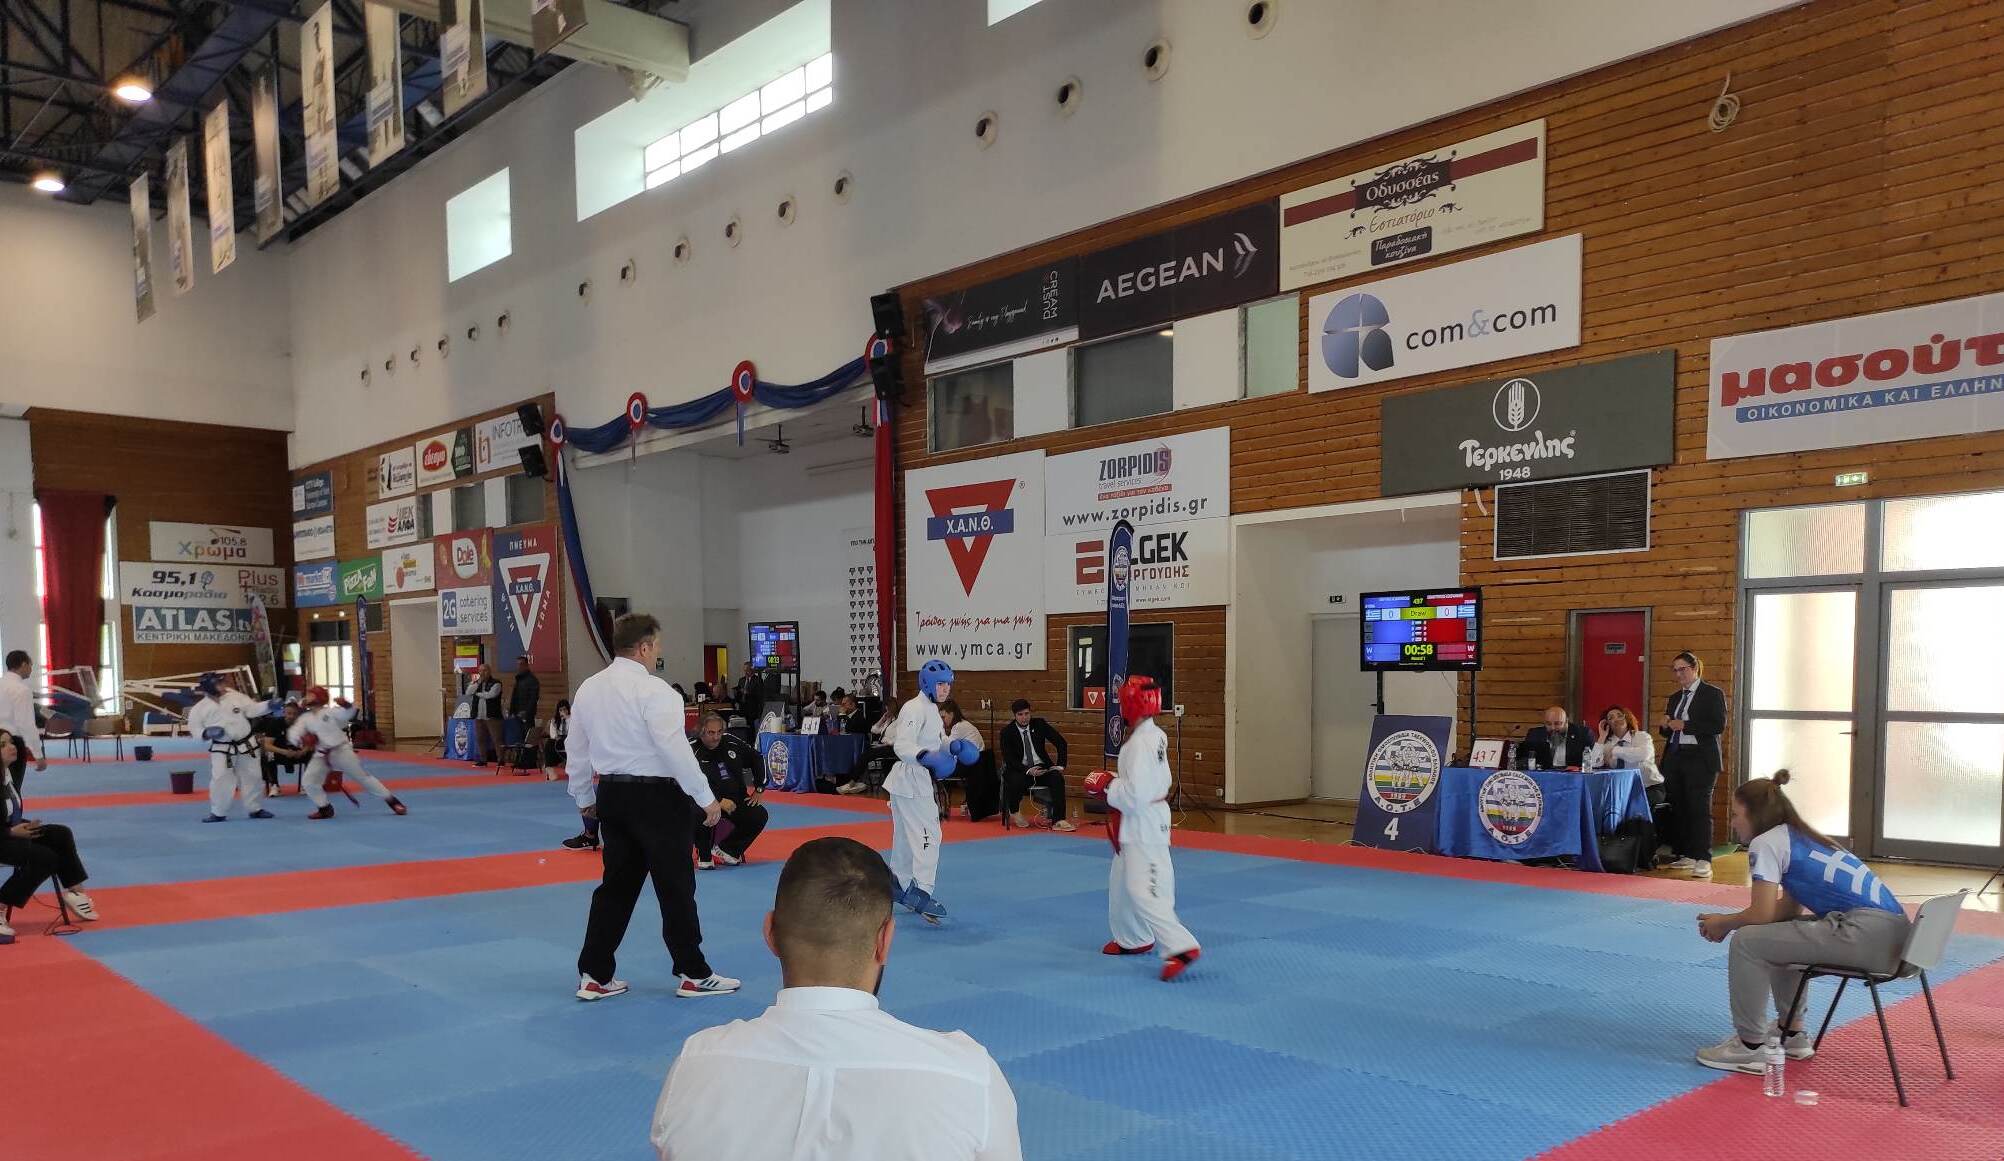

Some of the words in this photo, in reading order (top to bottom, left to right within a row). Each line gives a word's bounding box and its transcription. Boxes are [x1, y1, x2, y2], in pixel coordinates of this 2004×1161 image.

[1366, 171, 1440, 201] Οδυσσέας
[1370, 209, 1435, 233] Εστιατόριο
[1096, 248, 1224, 304] AEGEAN
[1049, 270, 1059, 319] CREAM
[1406, 303, 1557, 351] com&com
[1747, 394, 1873, 420] ΟΙΚΟΝΟΜΙΚΑ
[1884, 387, 1918, 403] ΚΑΙ
[1098, 450, 1170, 482] ZORPIDIS
[1499, 466, 1531, 480] 1948
[1063, 497, 1208, 526] www.zorpidis.gr
[1130, 531, 1189, 566] GEK
[238, 569, 278, 586] Plus
[244, 593, 279, 606] 12.6
[443, 599, 456, 620] 2G
[459, 594, 488, 610] catering
[138, 608, 233, 630] ATLAS
[459, 610, 488, 623] services
[1410, 609, 1428, 617] Draw
[137, 632, 192, 641] ΚΕΝΤΡΙΚΗ
[916, 642, 1033, 660] www.ymca.gr
[1404, 644, 1434, 655] 00:58
[1384, 817, 1399, 840] 4
